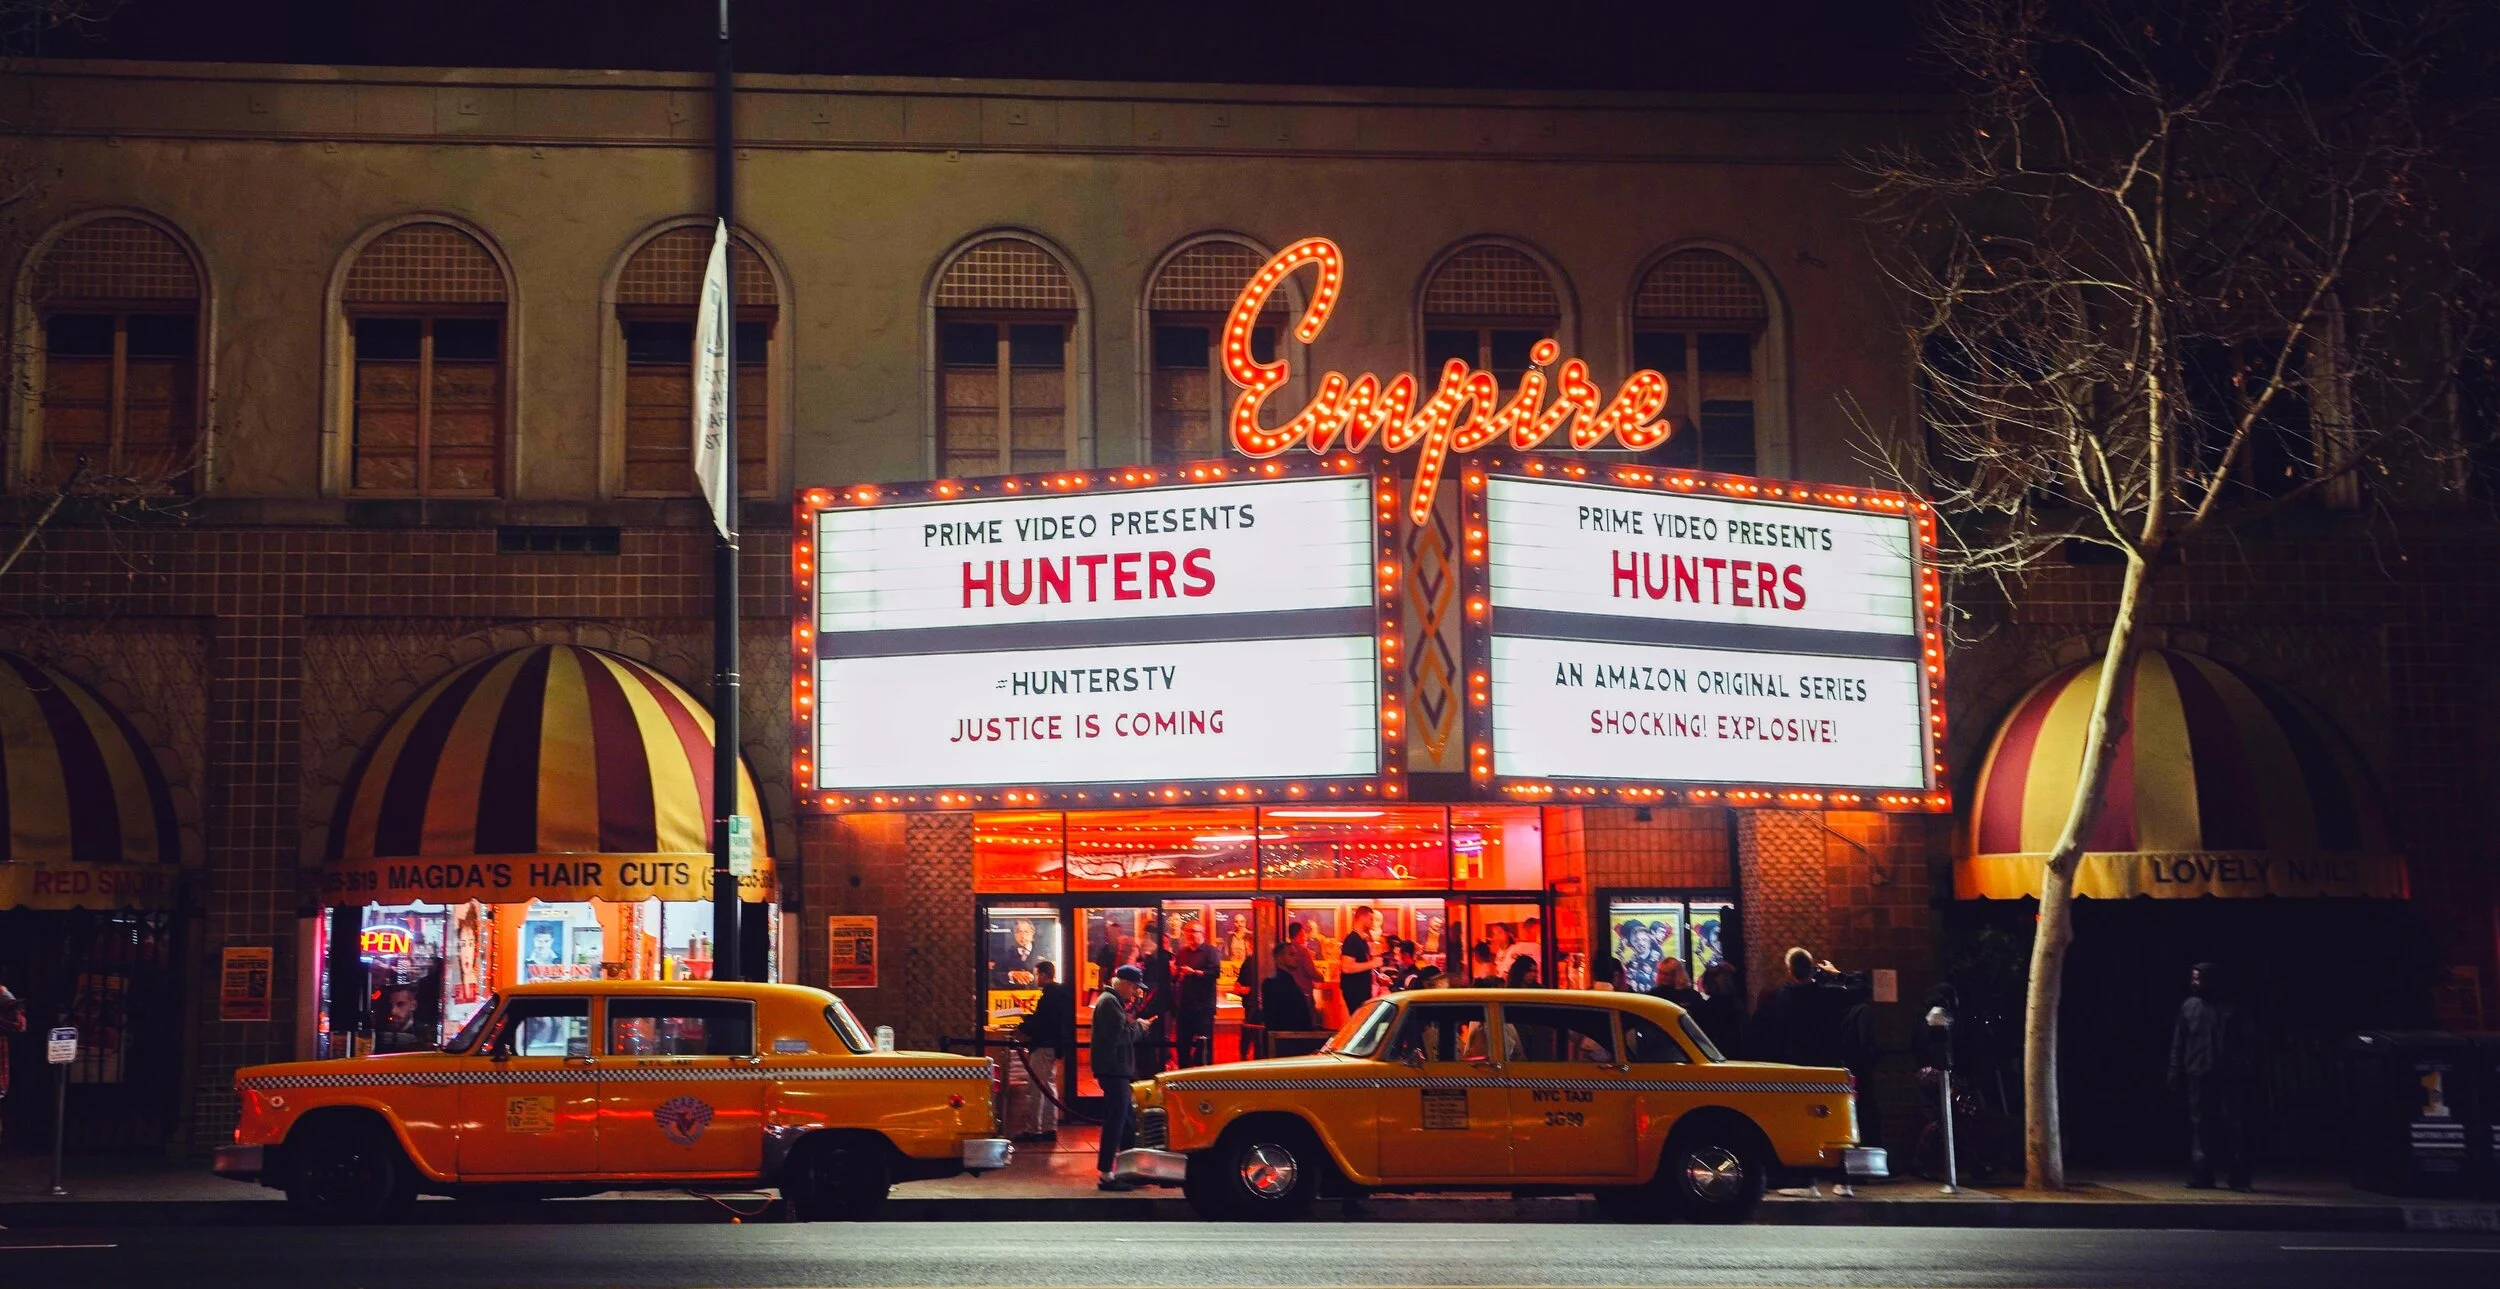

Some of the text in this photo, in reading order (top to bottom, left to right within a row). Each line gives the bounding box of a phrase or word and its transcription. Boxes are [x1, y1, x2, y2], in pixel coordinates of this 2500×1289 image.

[1221, 237, 1672, 526] Empire
[923, 503, 1256, 548] PRIME VIDEO PRESENTS
[1578, 505, 1834, 552] PRIME VIDEO PRESENTS
[961, 547, 1217, 609] HUNTERS
[1611, 549, 1808, 612] HUNTERS
[1555, 661, 1868, 703] AN AMAZON ORIGINAL SERIES
[949, 709, 1225, 743] JUSTICE IS COMING
[1590, 708, 1838, 744] SHOCKING! EXPLOSIVE!
[34, 870, 91, 895] RED
[388, 863, 512, 889] MAGDA'S
[529, 862, 602, 887] HAIR
[619, 862, 690, 886] CUTS
[2154, 857, 2270, 884] LOVELY
[528, 963, 592, 977] WALK-INS
[1564, 1090, 1593, 1103] TAXI
